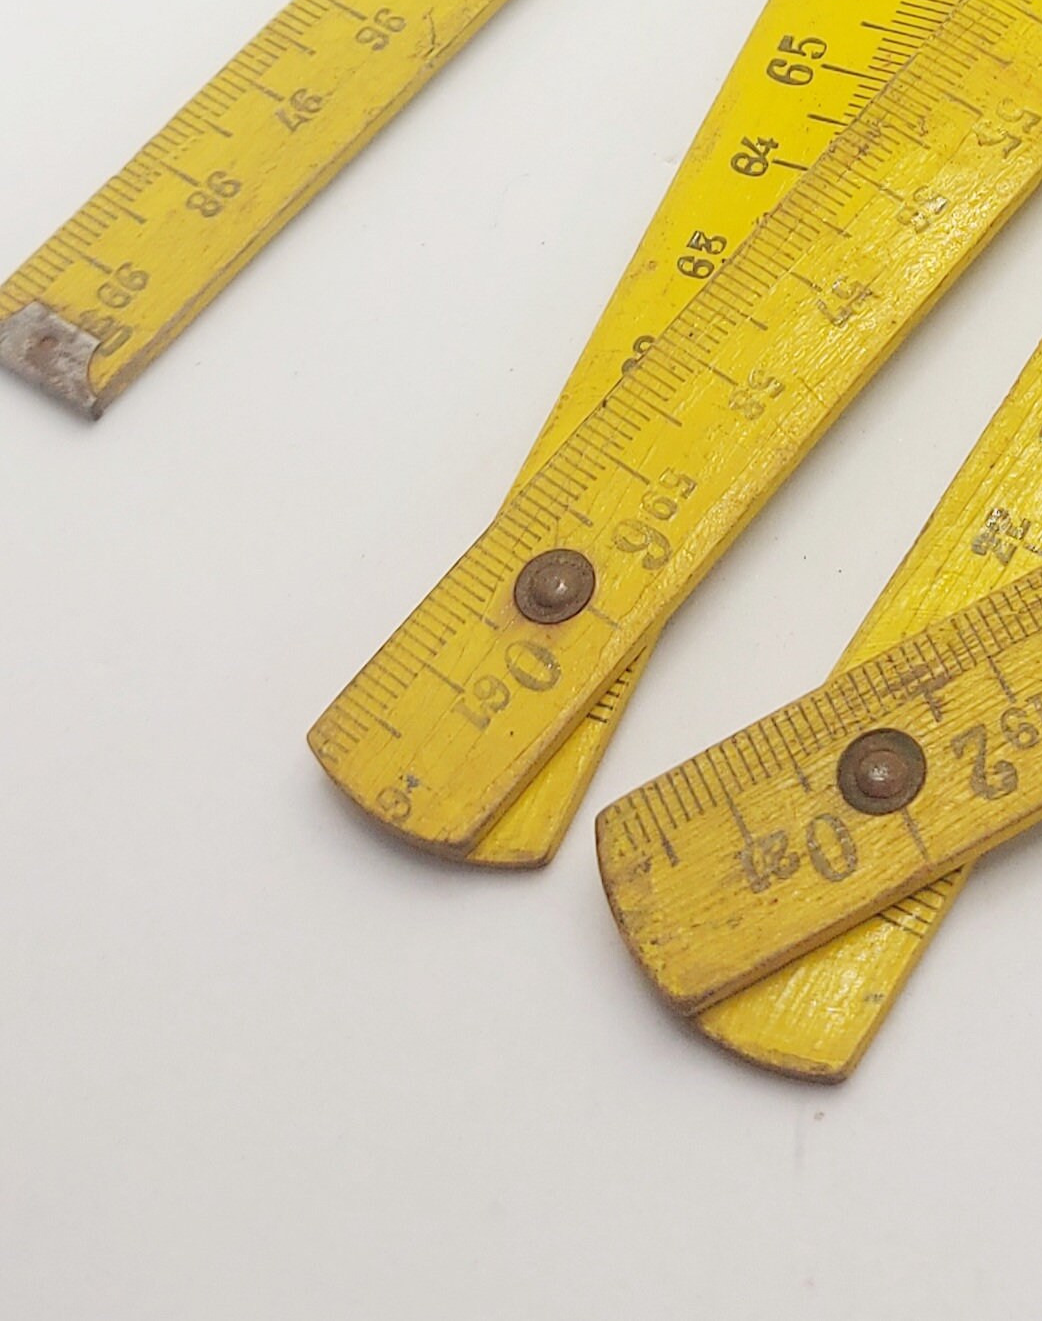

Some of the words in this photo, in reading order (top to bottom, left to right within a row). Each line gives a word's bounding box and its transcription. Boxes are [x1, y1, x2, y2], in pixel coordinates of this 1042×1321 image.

[355, 8, 406, 51] 96
[276, 88, 323, 133] 97
[731, 136, 779, 177] 64
[767, 35, 827, 86] 65
[973, 98, 1041, 159] 55
[186, 171, 241, 218] 98
[97, 262, 149, 309] 99
[640, 467, 697, 521] 59
